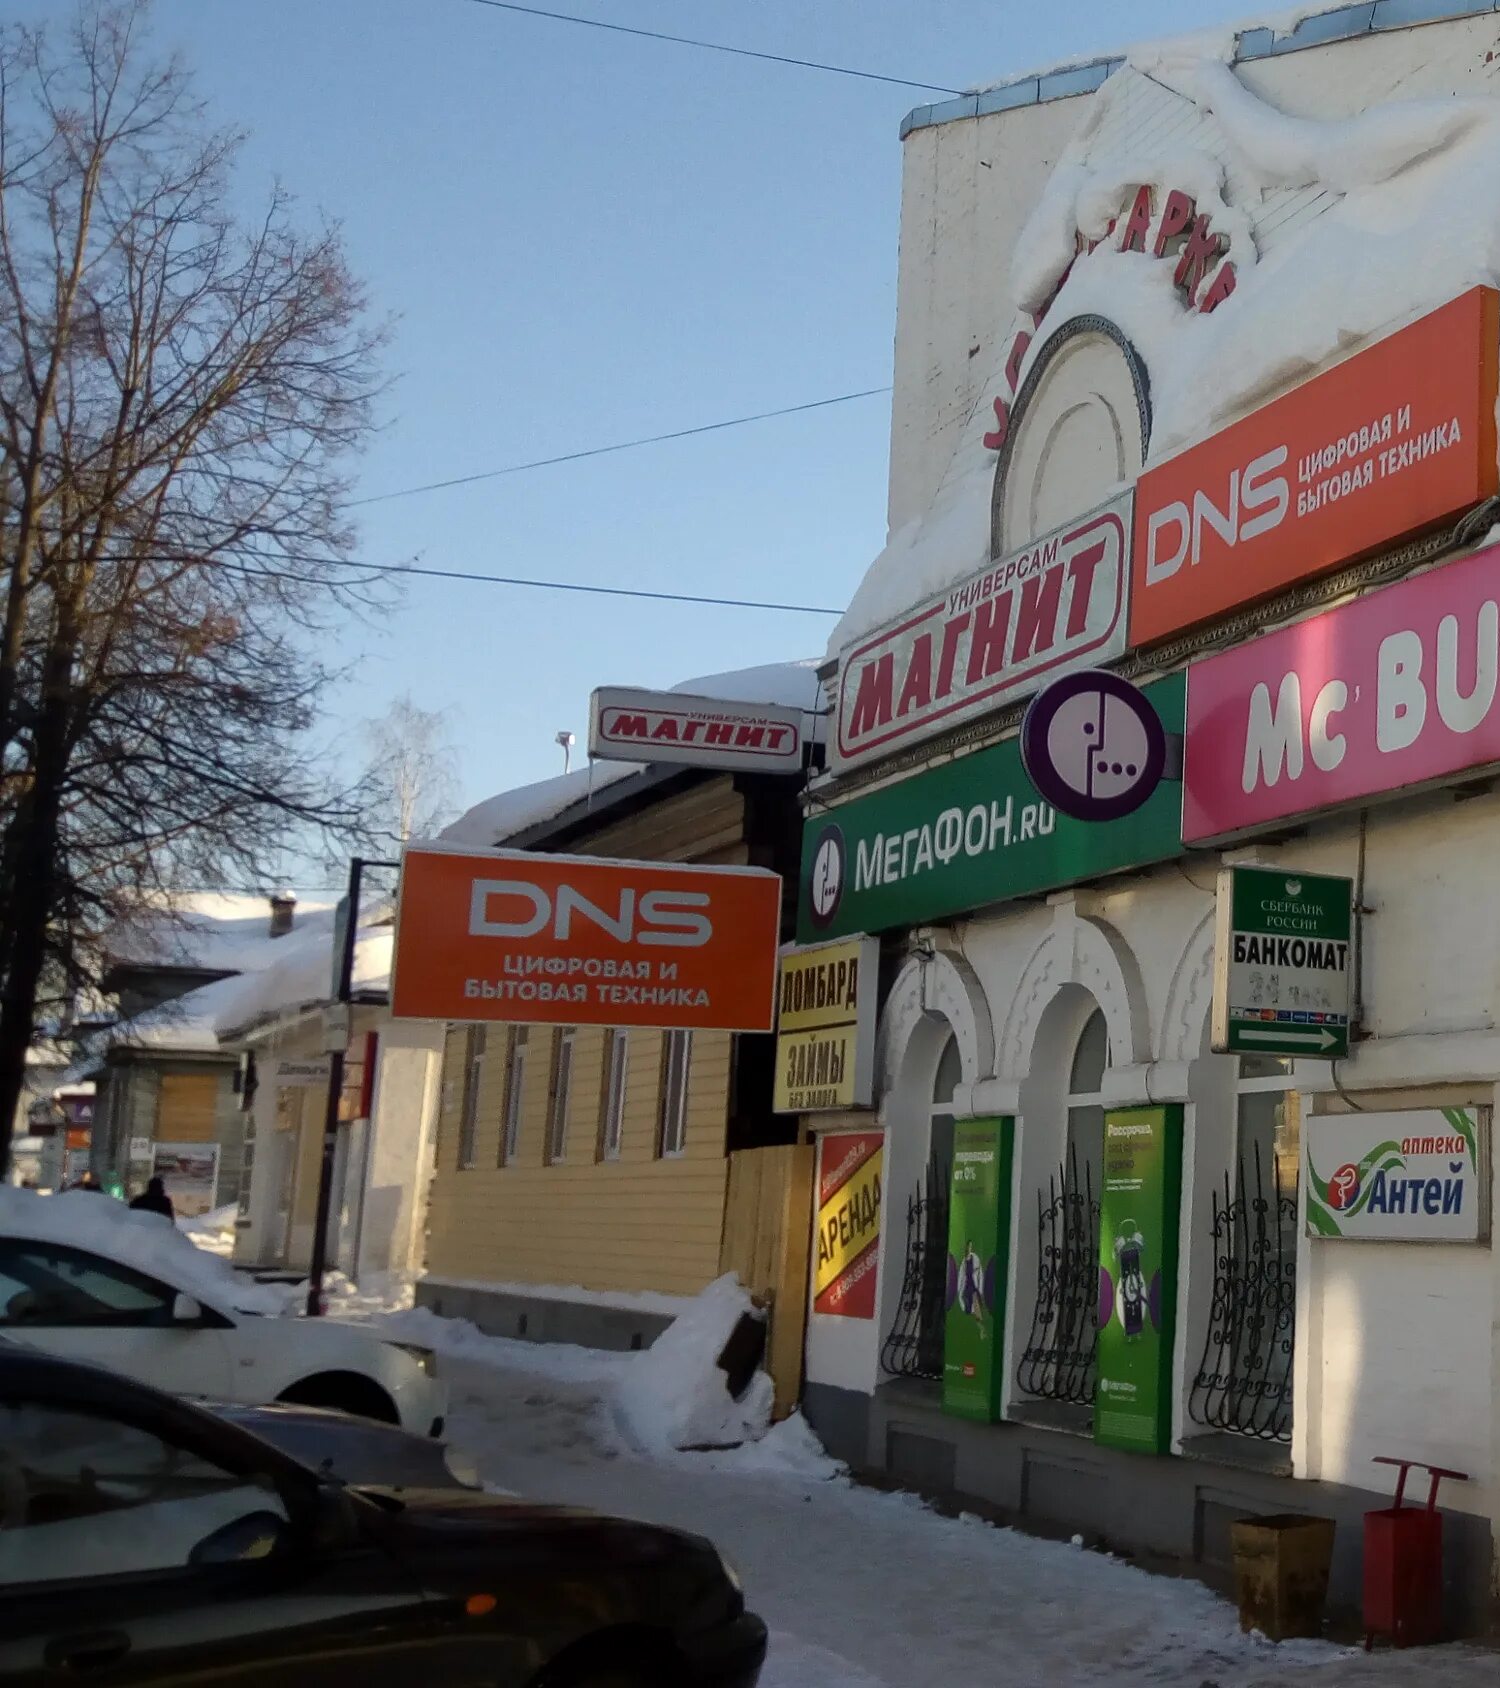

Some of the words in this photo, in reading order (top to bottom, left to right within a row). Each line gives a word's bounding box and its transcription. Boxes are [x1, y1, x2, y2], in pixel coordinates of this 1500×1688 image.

[1297, 459, 1373, 517] БЫТОВАЯ
[1379, 417, 1461, 478] ТЕХНИКА
[1298, 413, 1392, 484] ЦИФРОВАЯ
[1397, 404, 1410, 433] И
[1145, 445, 1289, 587] DNS
[948, 538, 1060, 614] УНИВЕРСАМ
[848, 536, 1106, 739] МАГНИТ
[609, 714, 789, 749] МАГНИТ
[469, 878, 713, 946] DNS
[1260, 899, 1324, 916] СБЕРБАНК
[1266, 915, 1318, 930] РОССИИ
[504, 954, 651, 980] ЦИФРОВАЯ
[659, 961, 678, 980] И
[1233, 934, 1348, 971] БАНКОМАТ
[464, 978, 588, 1001] БЫТОВАЯ
[596, 984, 711, 1007] ТЕХНИКА
[782, 957, 859, 1014] ЛОМБАРД
[786, 1034, 847, 1089] ЗАЙМЫ
[1401, 1134, 1465, 1156] аптека
[1366, 1161, 1464, 1216] Антей
[818, 1172, 882, 1271] АРЕНДА
